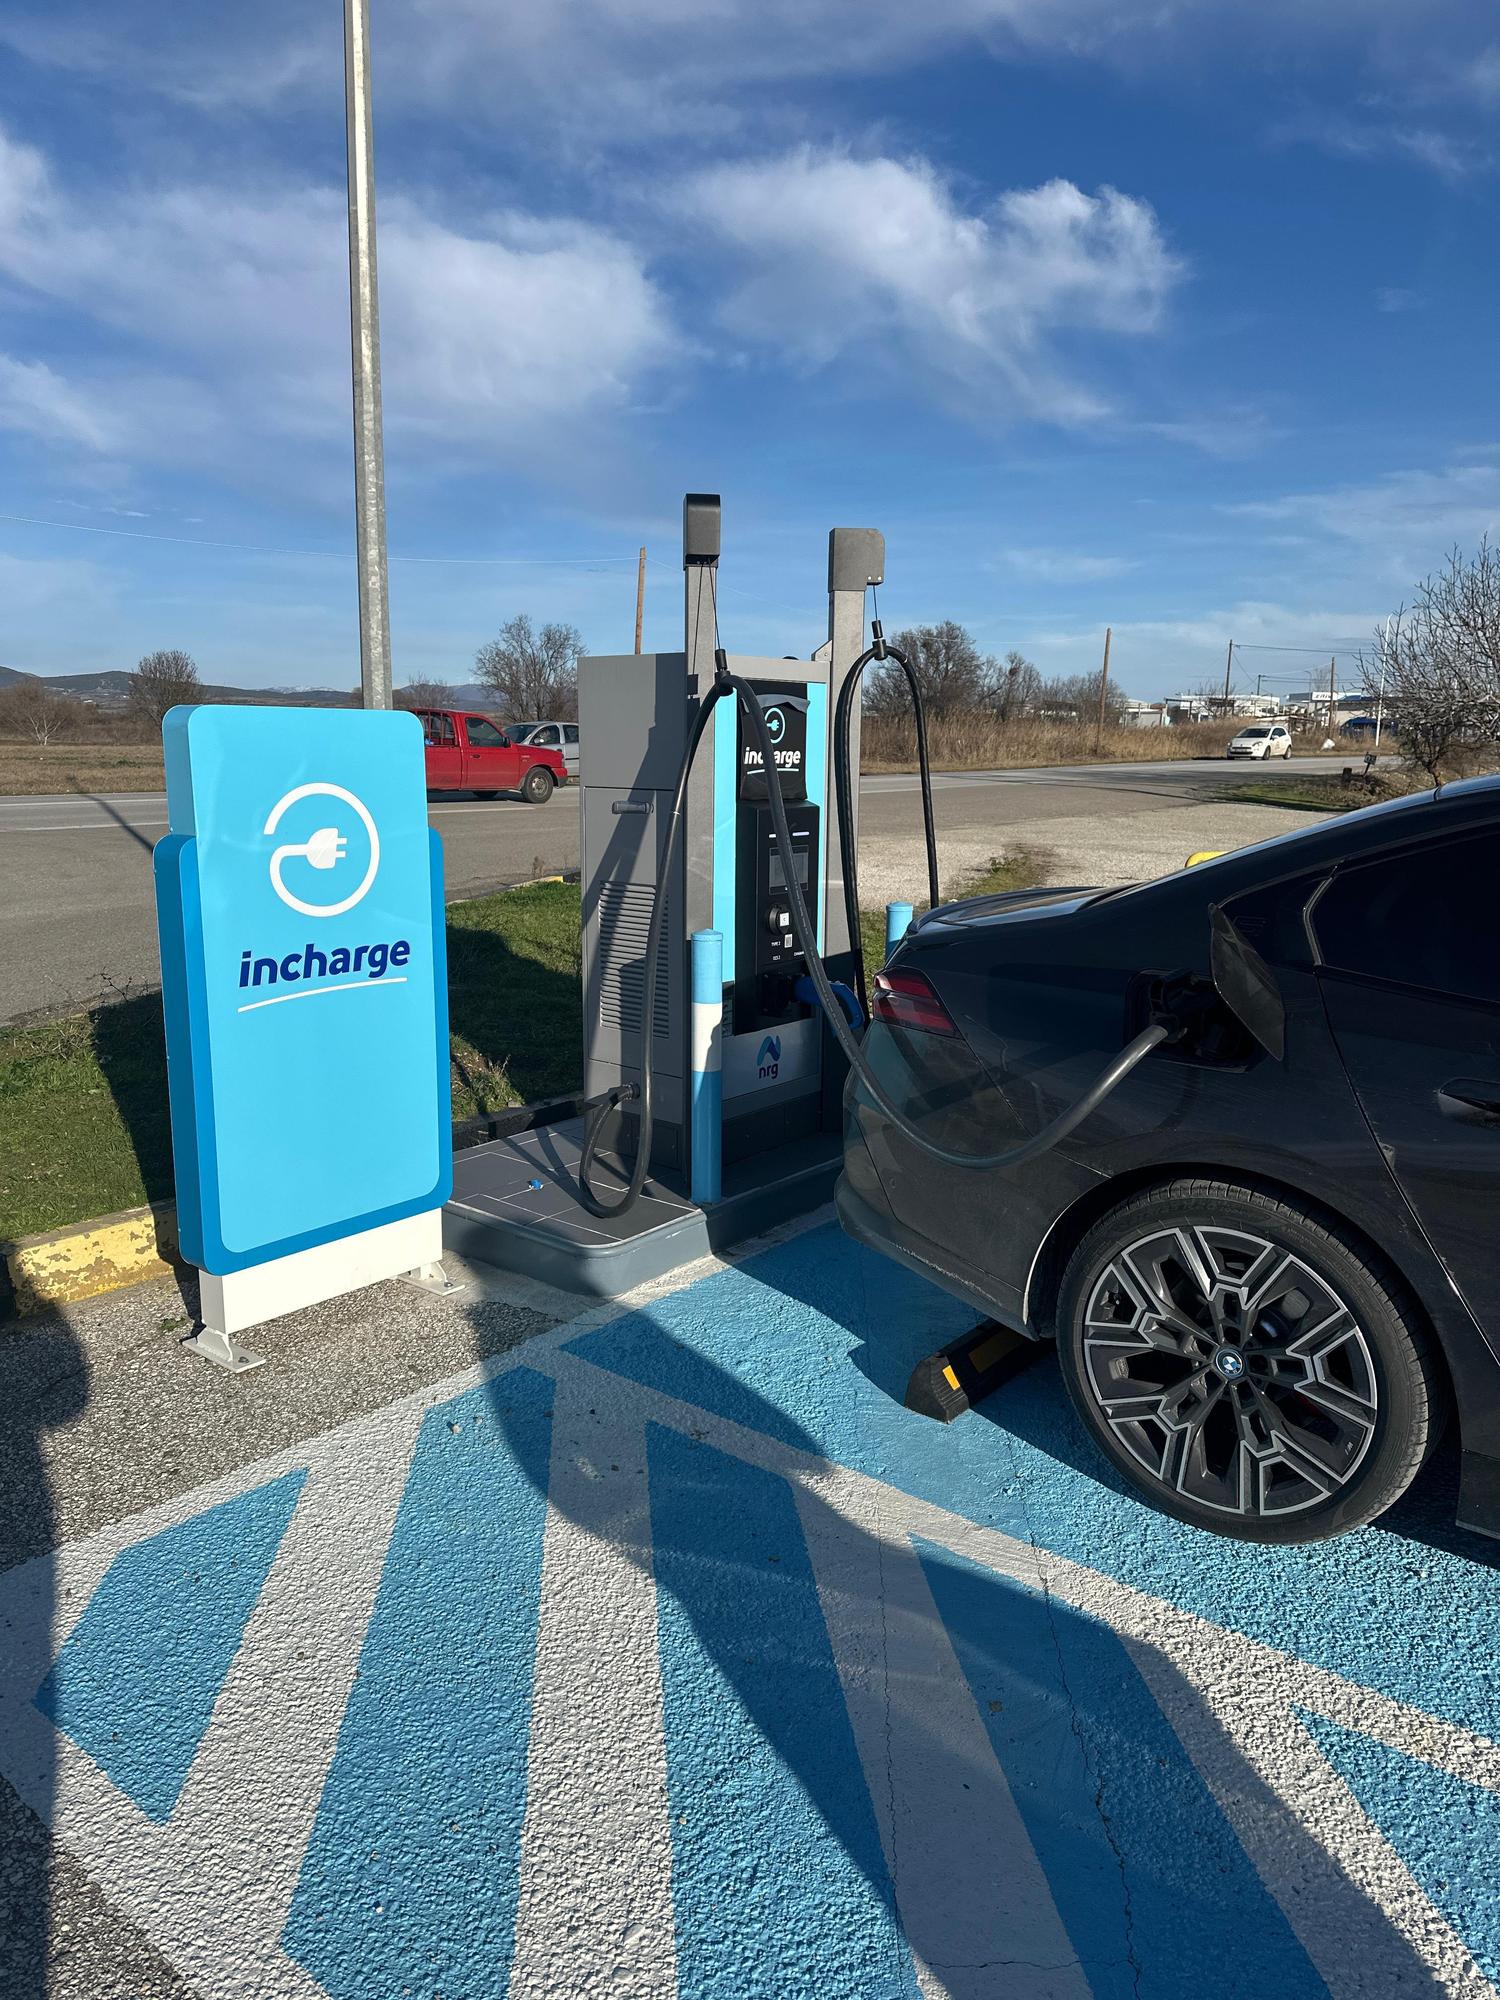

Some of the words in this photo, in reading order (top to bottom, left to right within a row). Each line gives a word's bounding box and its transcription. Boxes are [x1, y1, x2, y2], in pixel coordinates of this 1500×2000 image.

[744, 747, 801, 768] incarge
[239, 940, 411, 988] incharge
[759, 1063, 778, 1079] nrg
